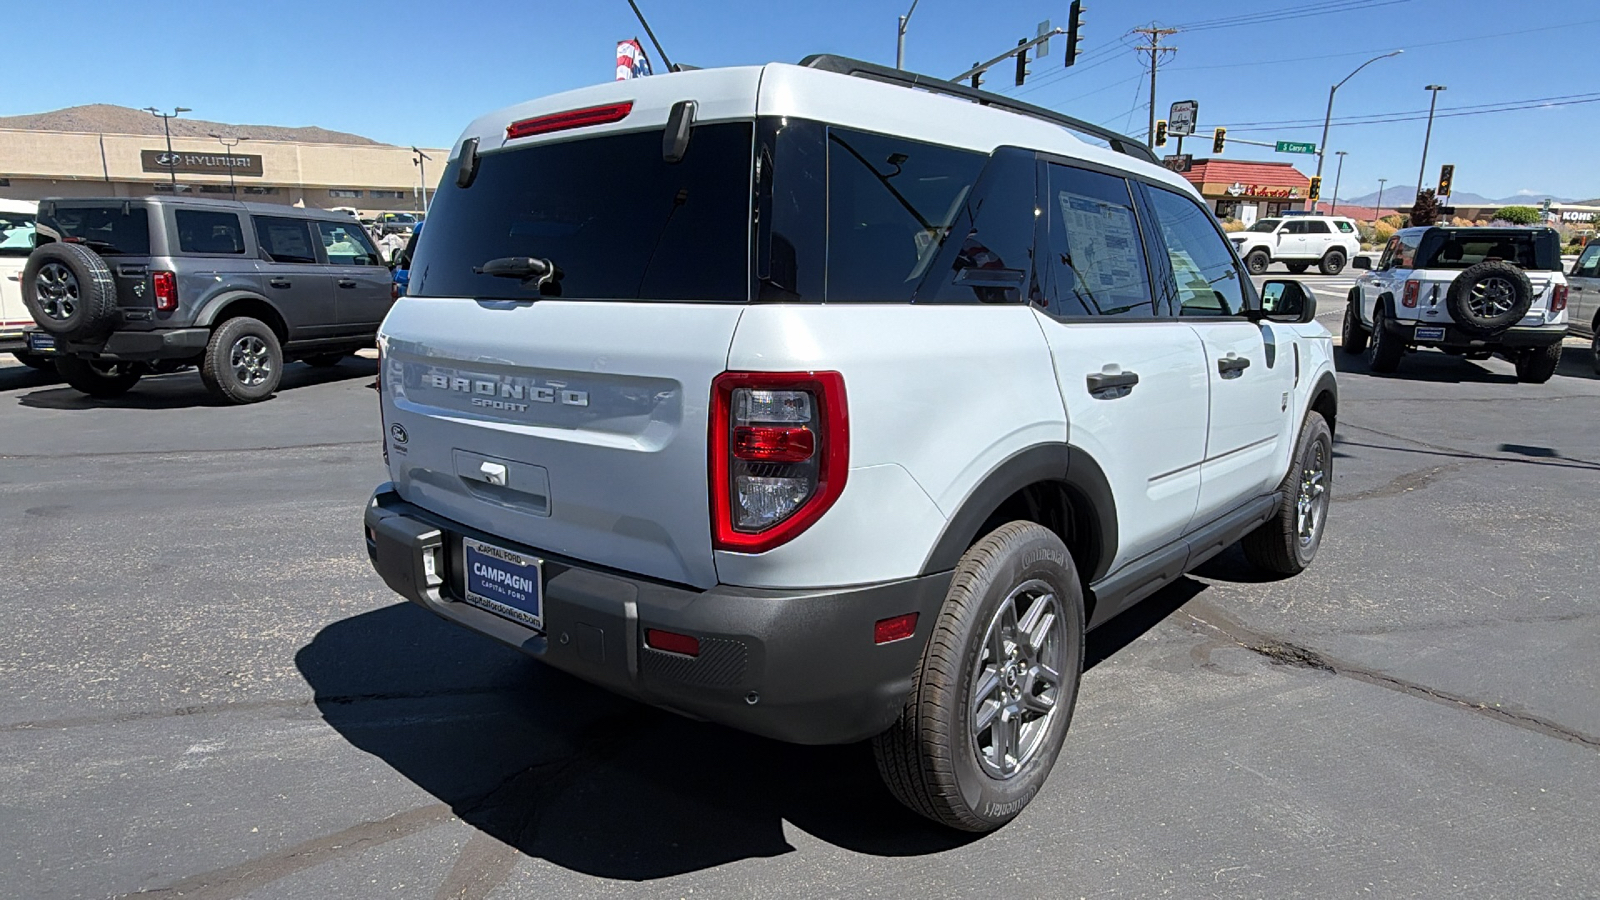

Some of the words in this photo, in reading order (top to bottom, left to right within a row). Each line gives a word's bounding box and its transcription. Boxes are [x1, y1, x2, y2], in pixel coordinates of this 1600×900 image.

[185, 155, 251, 167] HYUNDAI
[431, 374, 589, 407] BRONCO
[471, 397, 530, 413] SPORT
[479, 544, 503, 559] CAPITAL
[504, 552, 522, 563] FORD
[473, 562, 533, 594] CAMPAGNI
[481, 580, 506, 595] CAPITAL
[507, 589, 526, 601] FORD
